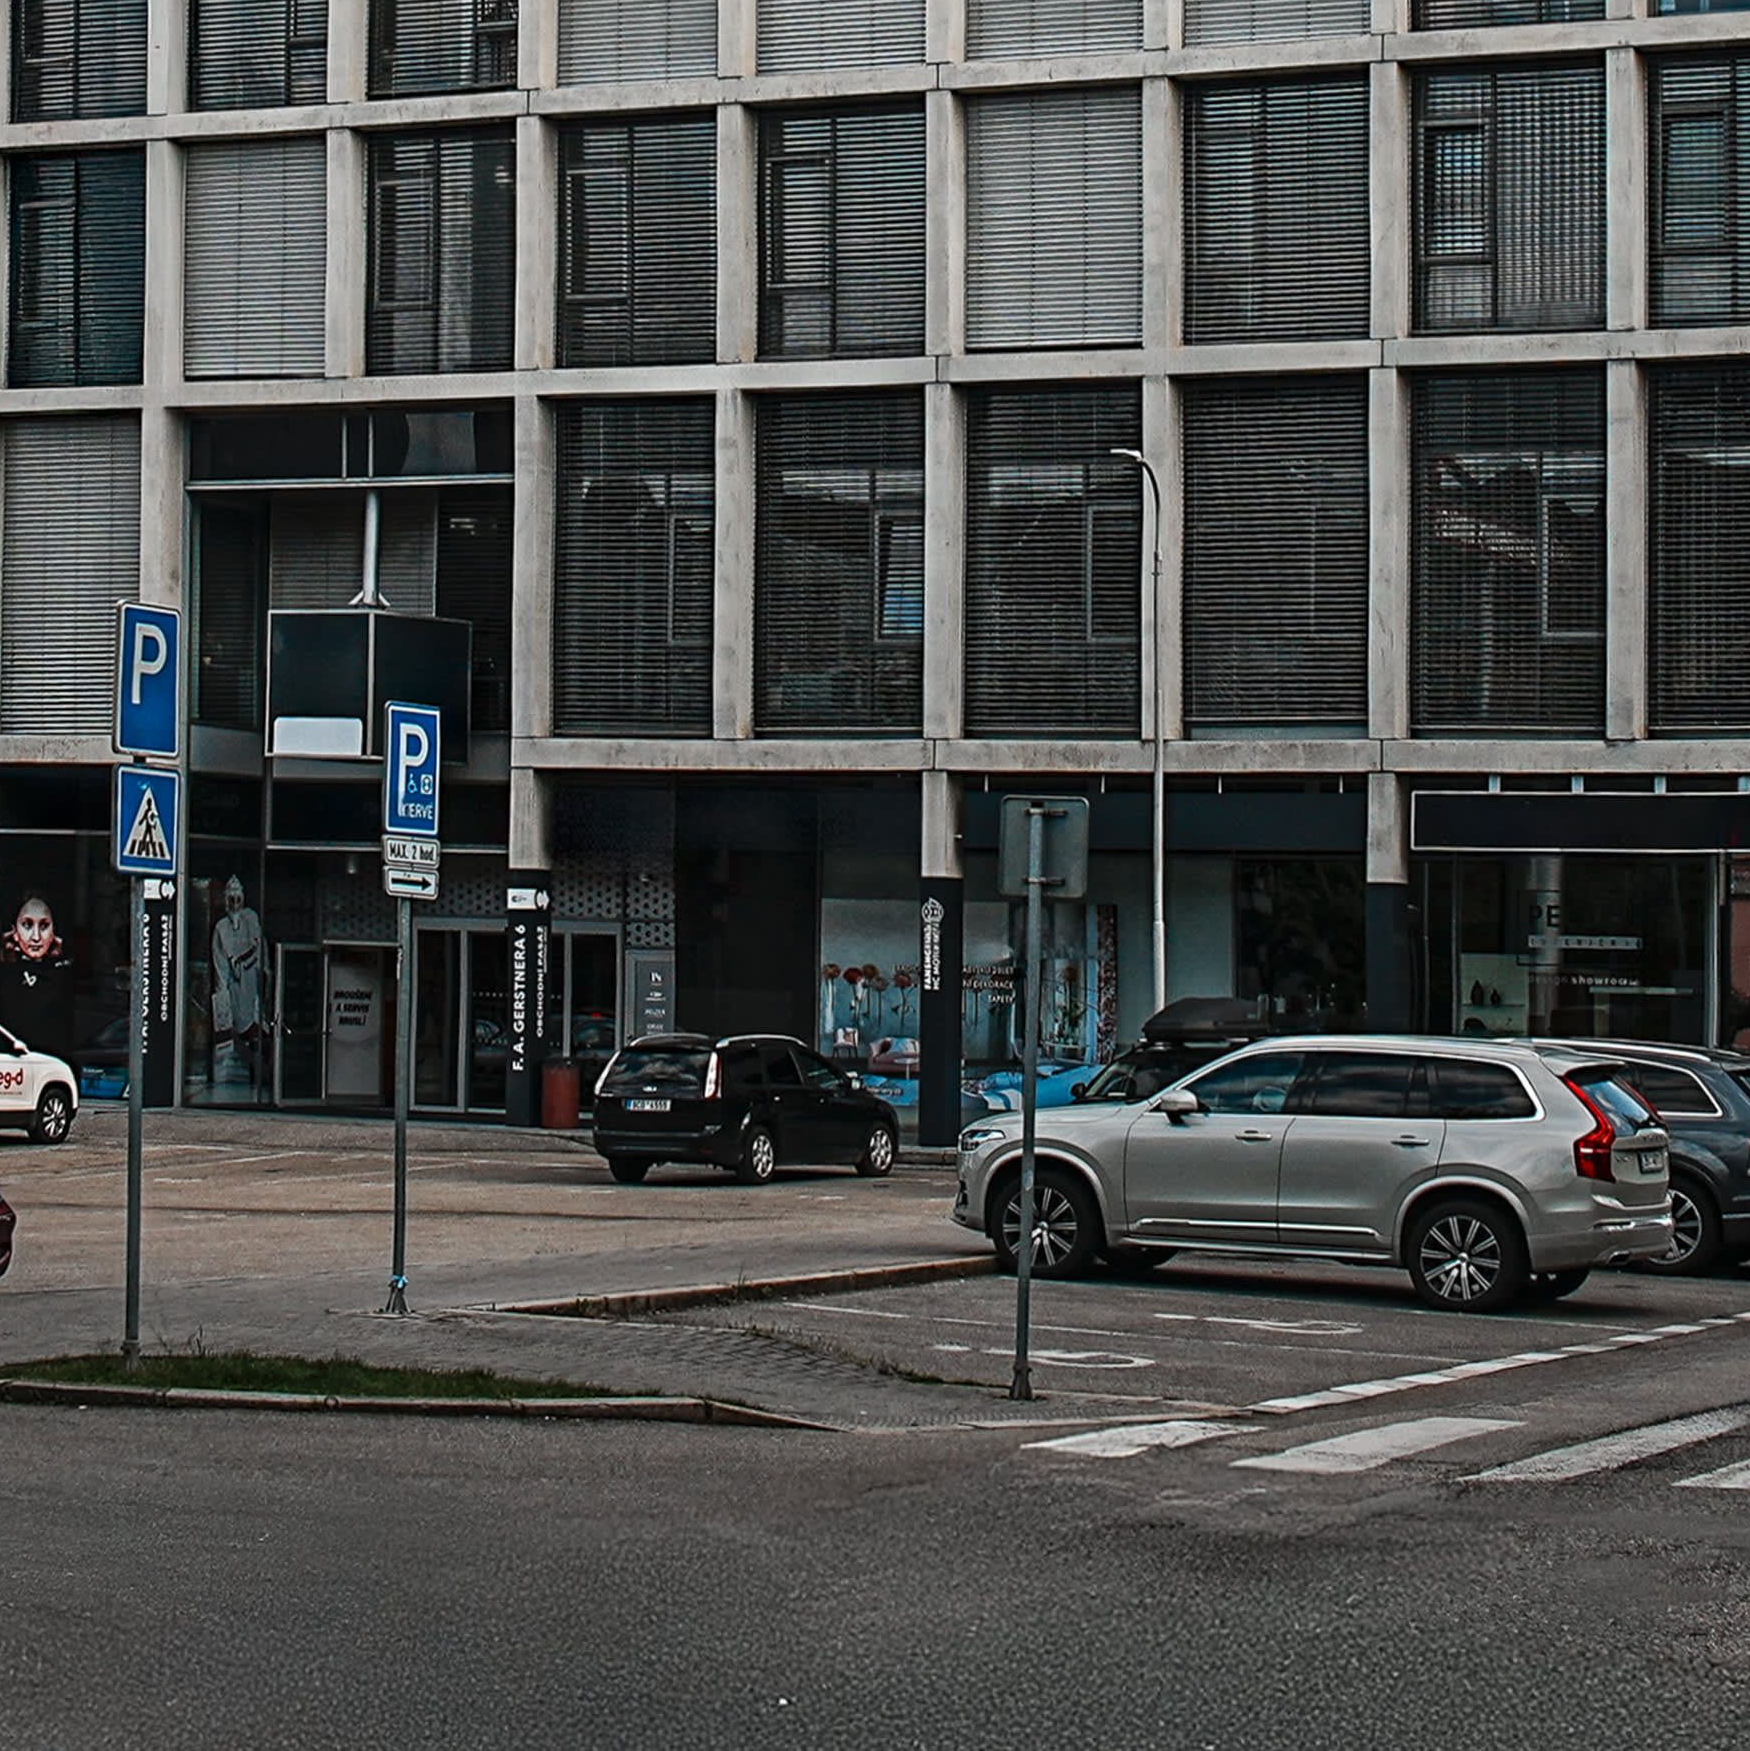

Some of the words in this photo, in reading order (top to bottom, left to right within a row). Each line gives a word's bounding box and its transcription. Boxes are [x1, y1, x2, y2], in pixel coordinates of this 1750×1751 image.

[132, 622, 167, 705] P
[398, 721, 429, 816] P
[412, 845, 417, 860] 2
[515, 924, 526, 934] 6
[513, 937, 526, 1033] GERSTNERA
[513, 1036, 525, 1054] A.
[513, 1058, 525, 1071] F.
